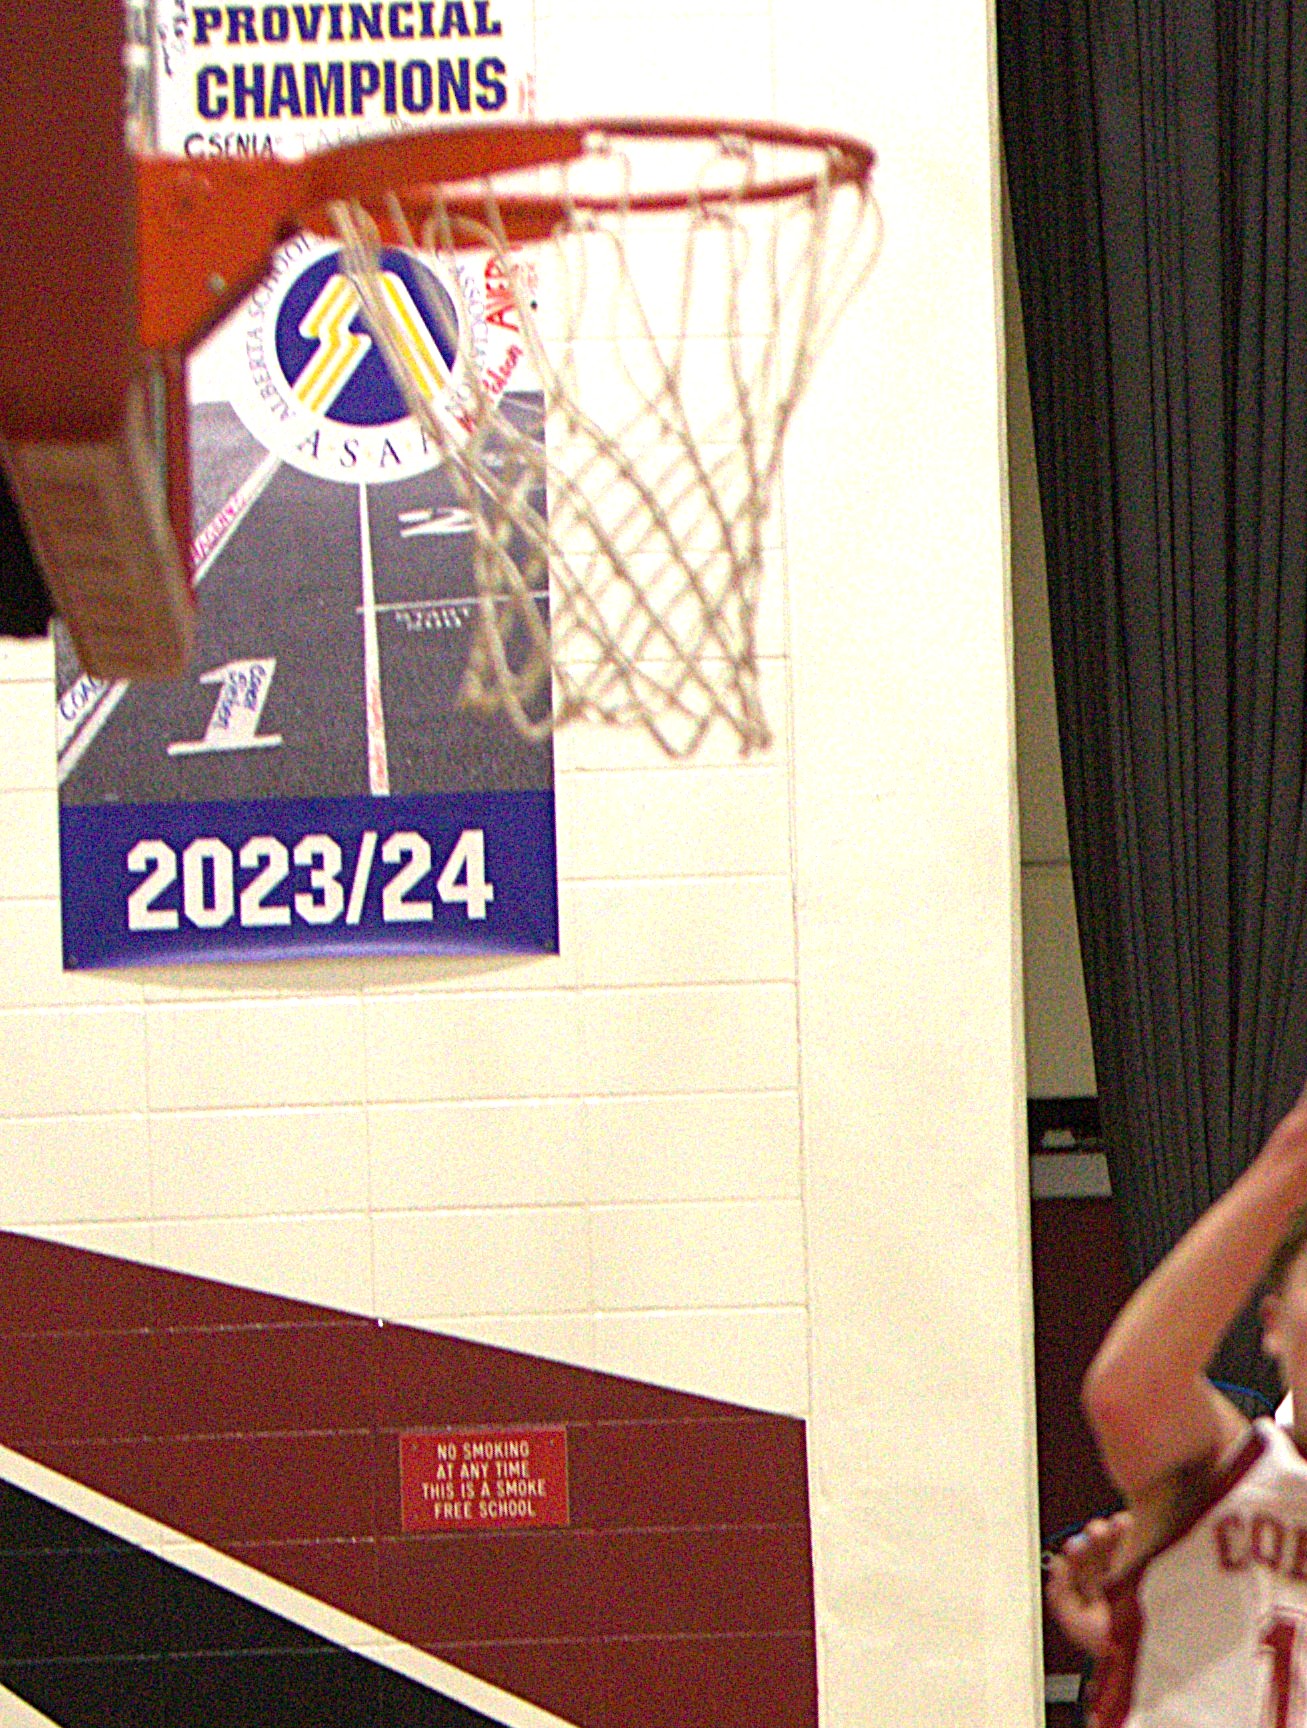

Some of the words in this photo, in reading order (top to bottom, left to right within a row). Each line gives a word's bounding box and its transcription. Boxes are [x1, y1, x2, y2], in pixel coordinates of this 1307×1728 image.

[192, 0, 502, 46] PROVINCIAL
[196, 56, 508, 119] CHAMPIONS
[126, 828, 494, 931] 2023/24
[437, 1442, 457, 1461] NO
[462, 1440, 530, 1461] SMOKING
[436, 1462, 454, 1480] AT
[460, 1461, 489, 1479] ANY
[495, 1460, 530, 1478] TIME
[421, 1481, 454, 1500] THIS
[461, 1481, 475, 1499] IS
[480, 1480, 491, 1499] A
[496, 1478, 548, 1498] SMOKE
[434, 1500, 472, 1520] FREE
[479, 1499, 537, 1519] SCHOOL
